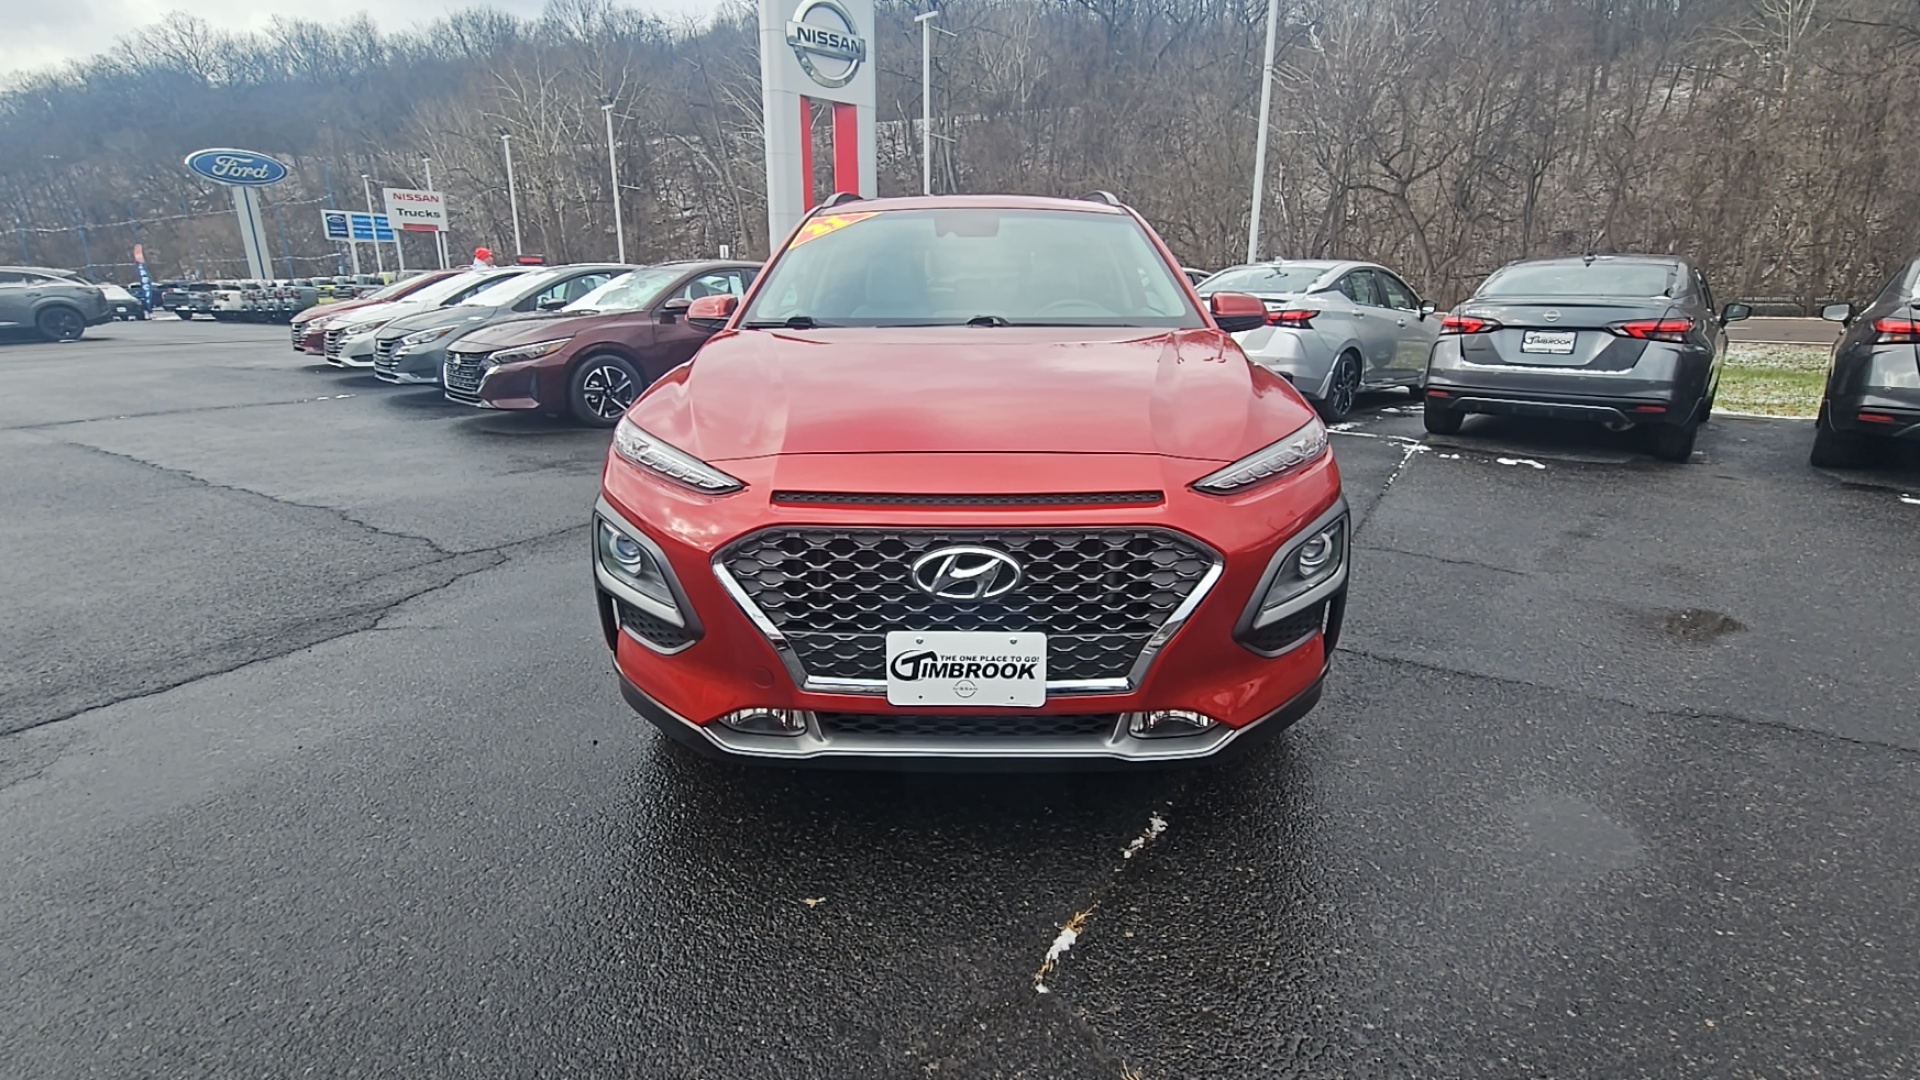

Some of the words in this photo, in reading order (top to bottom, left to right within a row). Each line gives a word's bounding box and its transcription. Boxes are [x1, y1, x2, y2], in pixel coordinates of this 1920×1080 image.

[796, 26, 860, 54] NISSAN
[211, 155, 269, 179] Ford
[392, 192, 440, 203] NISSAN
[395, 207, 441, 218] Trucks
[890, 649, 1038, 681] TIMBROOK
[940, 654, 957, 662] THE
[959, 654, 977, 662] ONE
[979, 655, 1007, 663] PLACE
